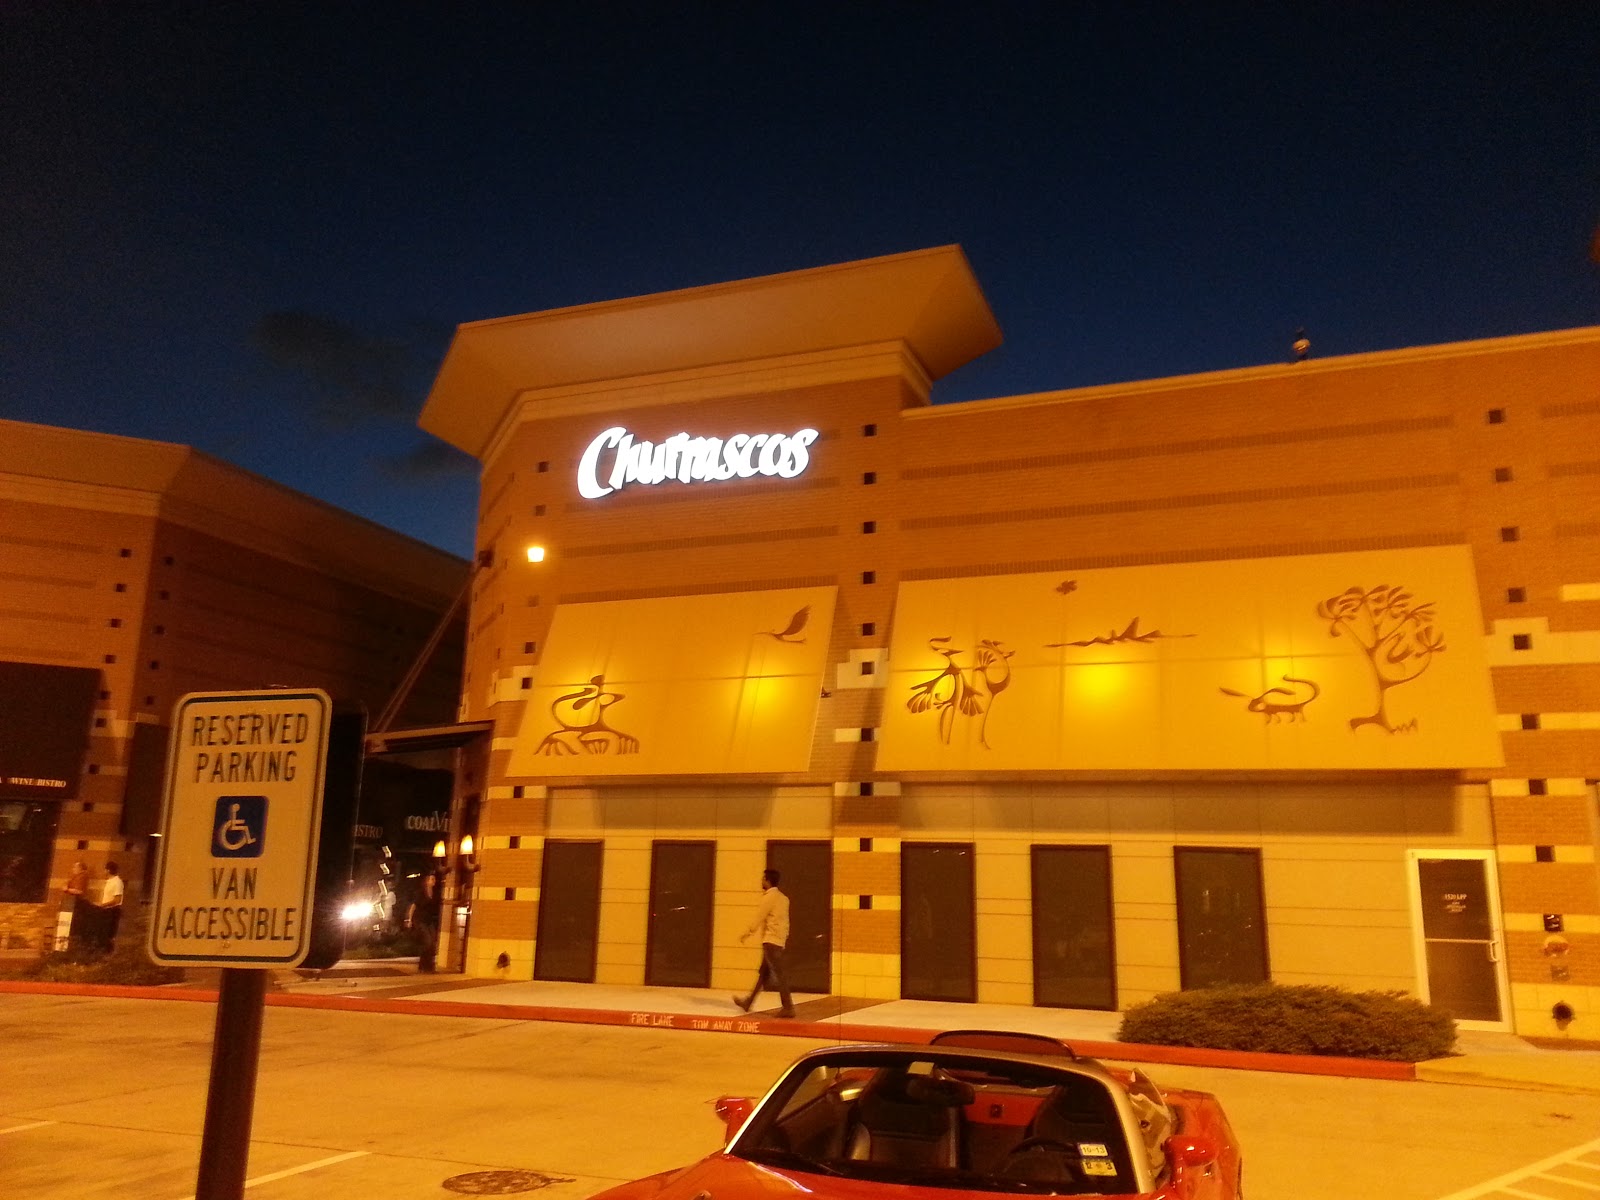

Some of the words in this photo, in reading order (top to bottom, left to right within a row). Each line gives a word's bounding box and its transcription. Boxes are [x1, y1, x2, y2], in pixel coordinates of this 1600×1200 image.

[577, 426, 819, 499] Churrascos
[192, 713, 308, 746] RESERVED
[37, 778, 66, 787] BISTRO
[194, 750, 298, 783] PARKING
[353, 824, 383, 837] ISTRO
[211, 867, 258, 900] VAN
[164, 907, 296, 940] ACCESSIBLE
[631, 1013, 650, 1025] FIRE
[652, 1015, 674, 1027] LANE
[692, 1019, 709, 1030] TOW
[713, 1020, 734, 1032] AWAY
[738, 1021, 760, 1033] ZONE
